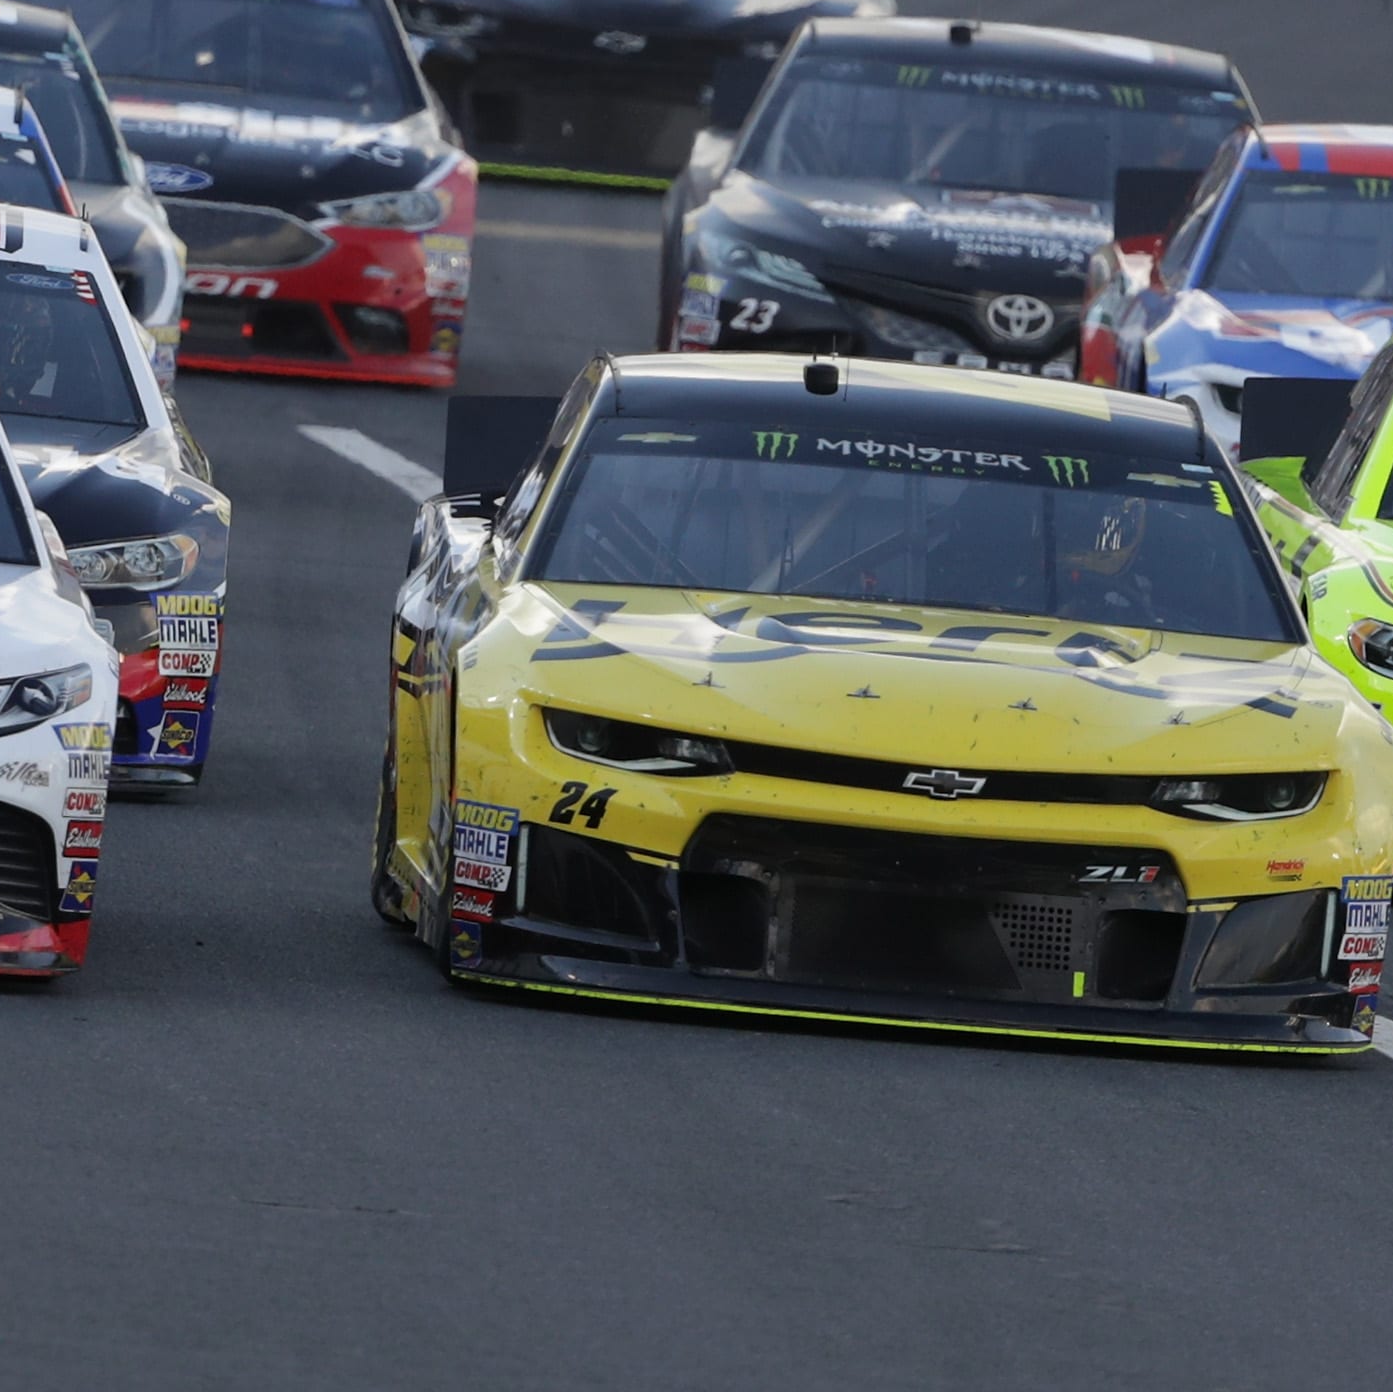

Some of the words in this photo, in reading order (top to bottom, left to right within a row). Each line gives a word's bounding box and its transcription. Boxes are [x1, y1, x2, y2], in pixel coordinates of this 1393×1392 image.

[729, 297, 782, 334] 23
[816, 437, 1031, 471] MONSTER
[157, 594, 218, 615] MOOG
[160, 618, 217, 643] MAHLE
[161, 653, 200, 671] COMP
[457, 801, 518, 832] MOOG
[548, 780, 619, 830] 24
[455, 830, 506, 858] MAHLE
[457, 860, 491, 883] COMP
[1077, 865, 1161, 883] ZL1
[1344, 879, 1392, 900] MOOG
